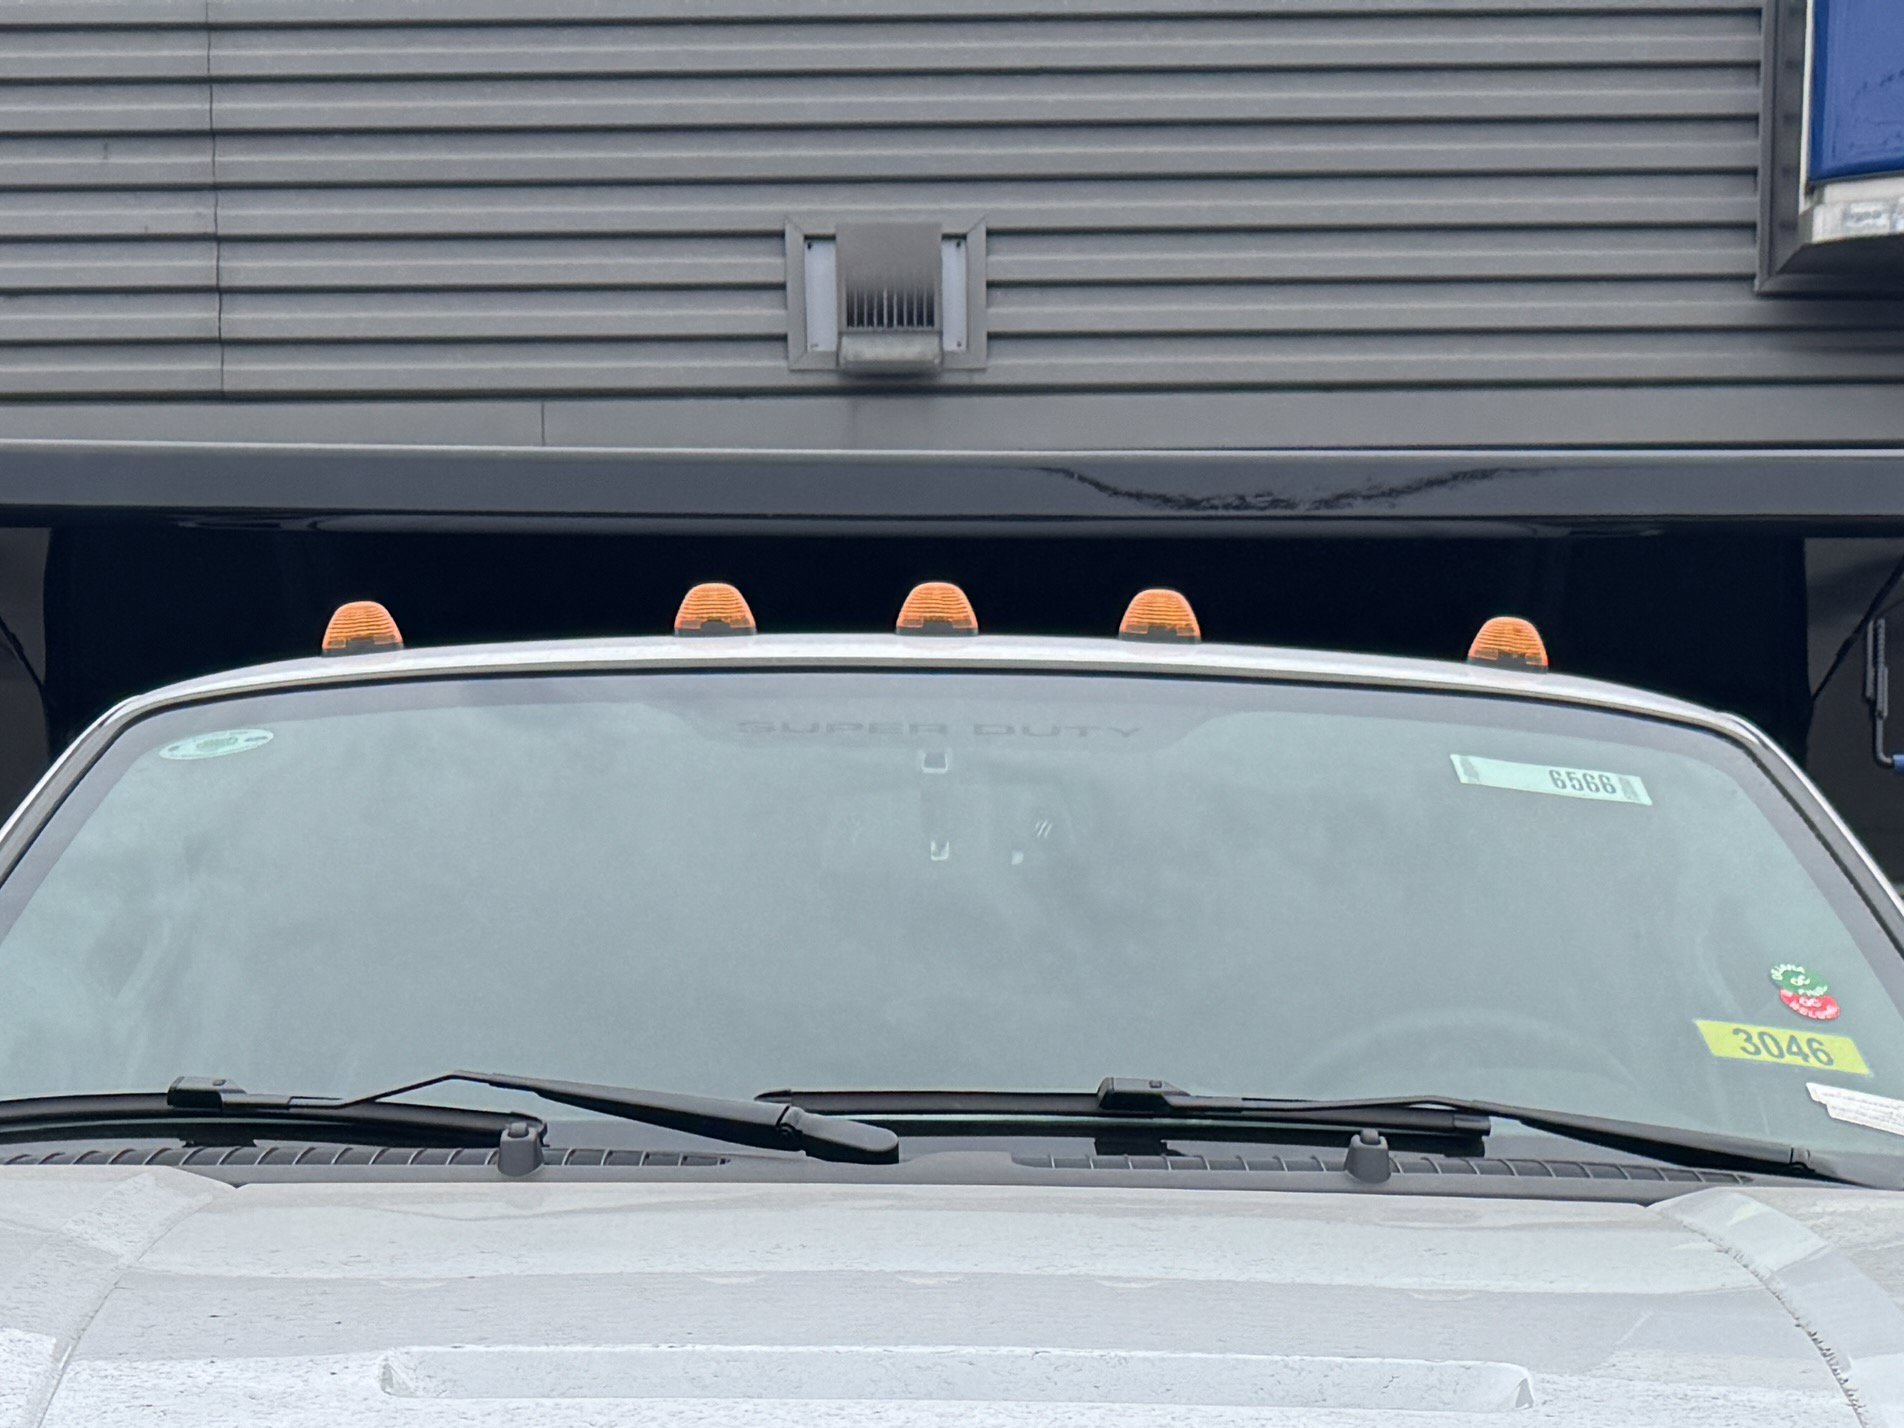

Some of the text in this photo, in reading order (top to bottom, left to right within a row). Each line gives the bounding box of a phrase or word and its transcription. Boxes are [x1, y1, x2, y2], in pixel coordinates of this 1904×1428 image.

[735, 719, 1144, 739] SUPER DUTY
[1732, 1027, 1834, 1067] 3046
